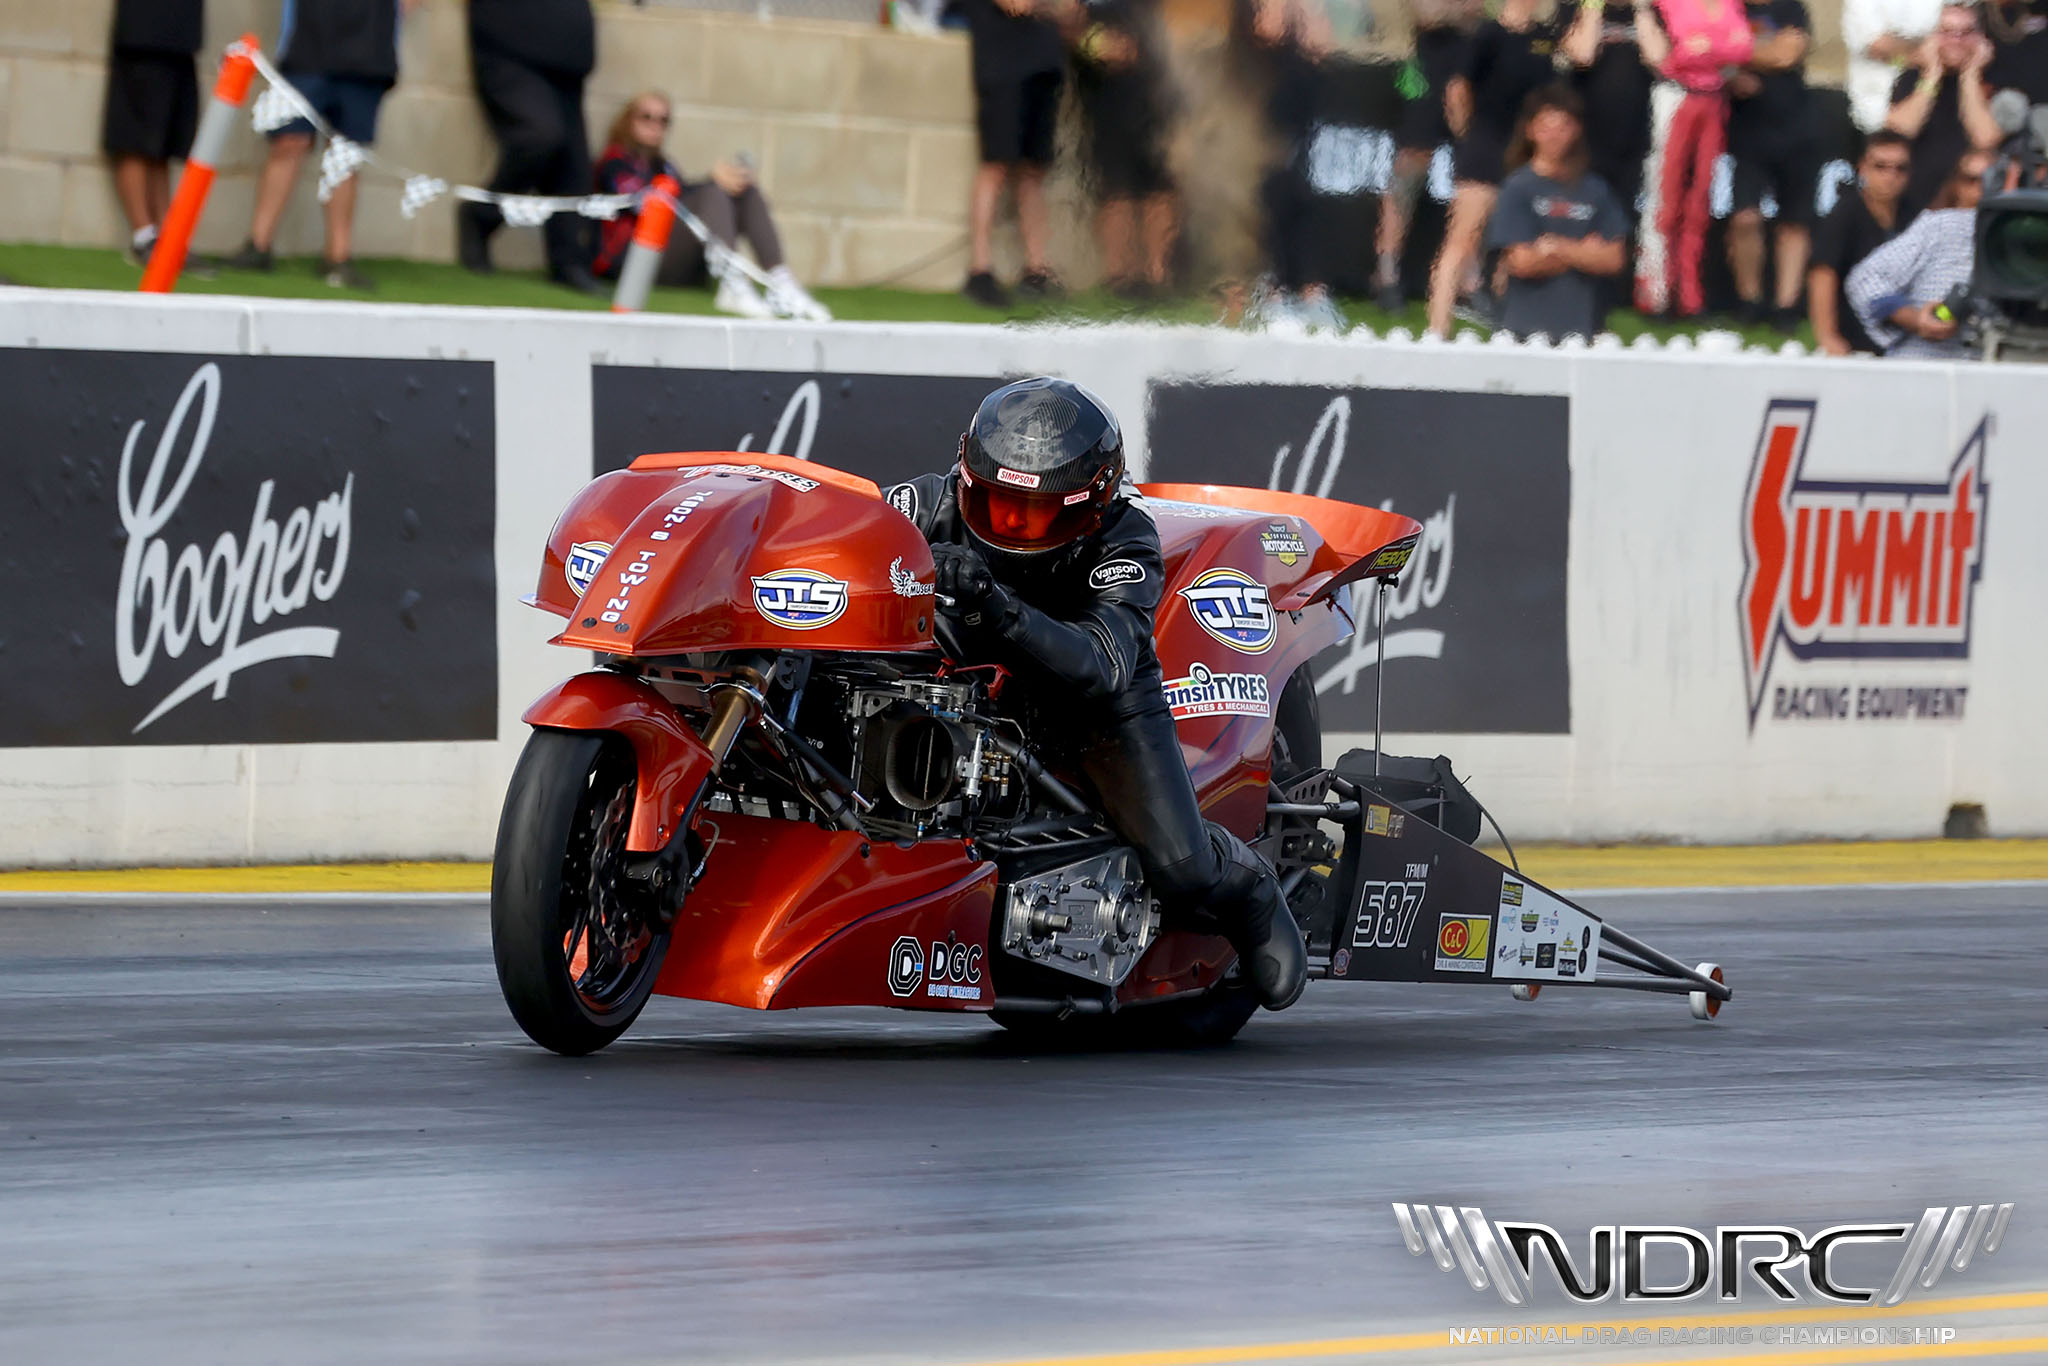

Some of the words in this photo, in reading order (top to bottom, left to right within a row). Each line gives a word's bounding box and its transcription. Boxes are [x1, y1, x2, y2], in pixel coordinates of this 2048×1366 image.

[1000, 470, 1036, 485] SIMPSON
[1066, 493, 1088, 503] SIMPSON
[115, 363, 354, 700] Coopers
[650, 491, 714, 541] JASON'S
[1262, 540, 1305, 552] MOTORCYCLE
[571, 546, 613, 580] JT
[600, 551, 656, 623] TOWING
[754, 580, 845, 613] JTS
[1183, 587, 1269, 629] JTS
[1185, 703, 1215, 713] TYRES
[1225, 703, 1267, 713] MECHANICAL
[1772, 687, 1848, 719] RACING
[1856, 687, 1968, 719] EQUIPMENT
[1352, 881, 1426, 947] 587
[1445, 928, 1463, 948] C&C
[929, 941, 983, 984] DGC
